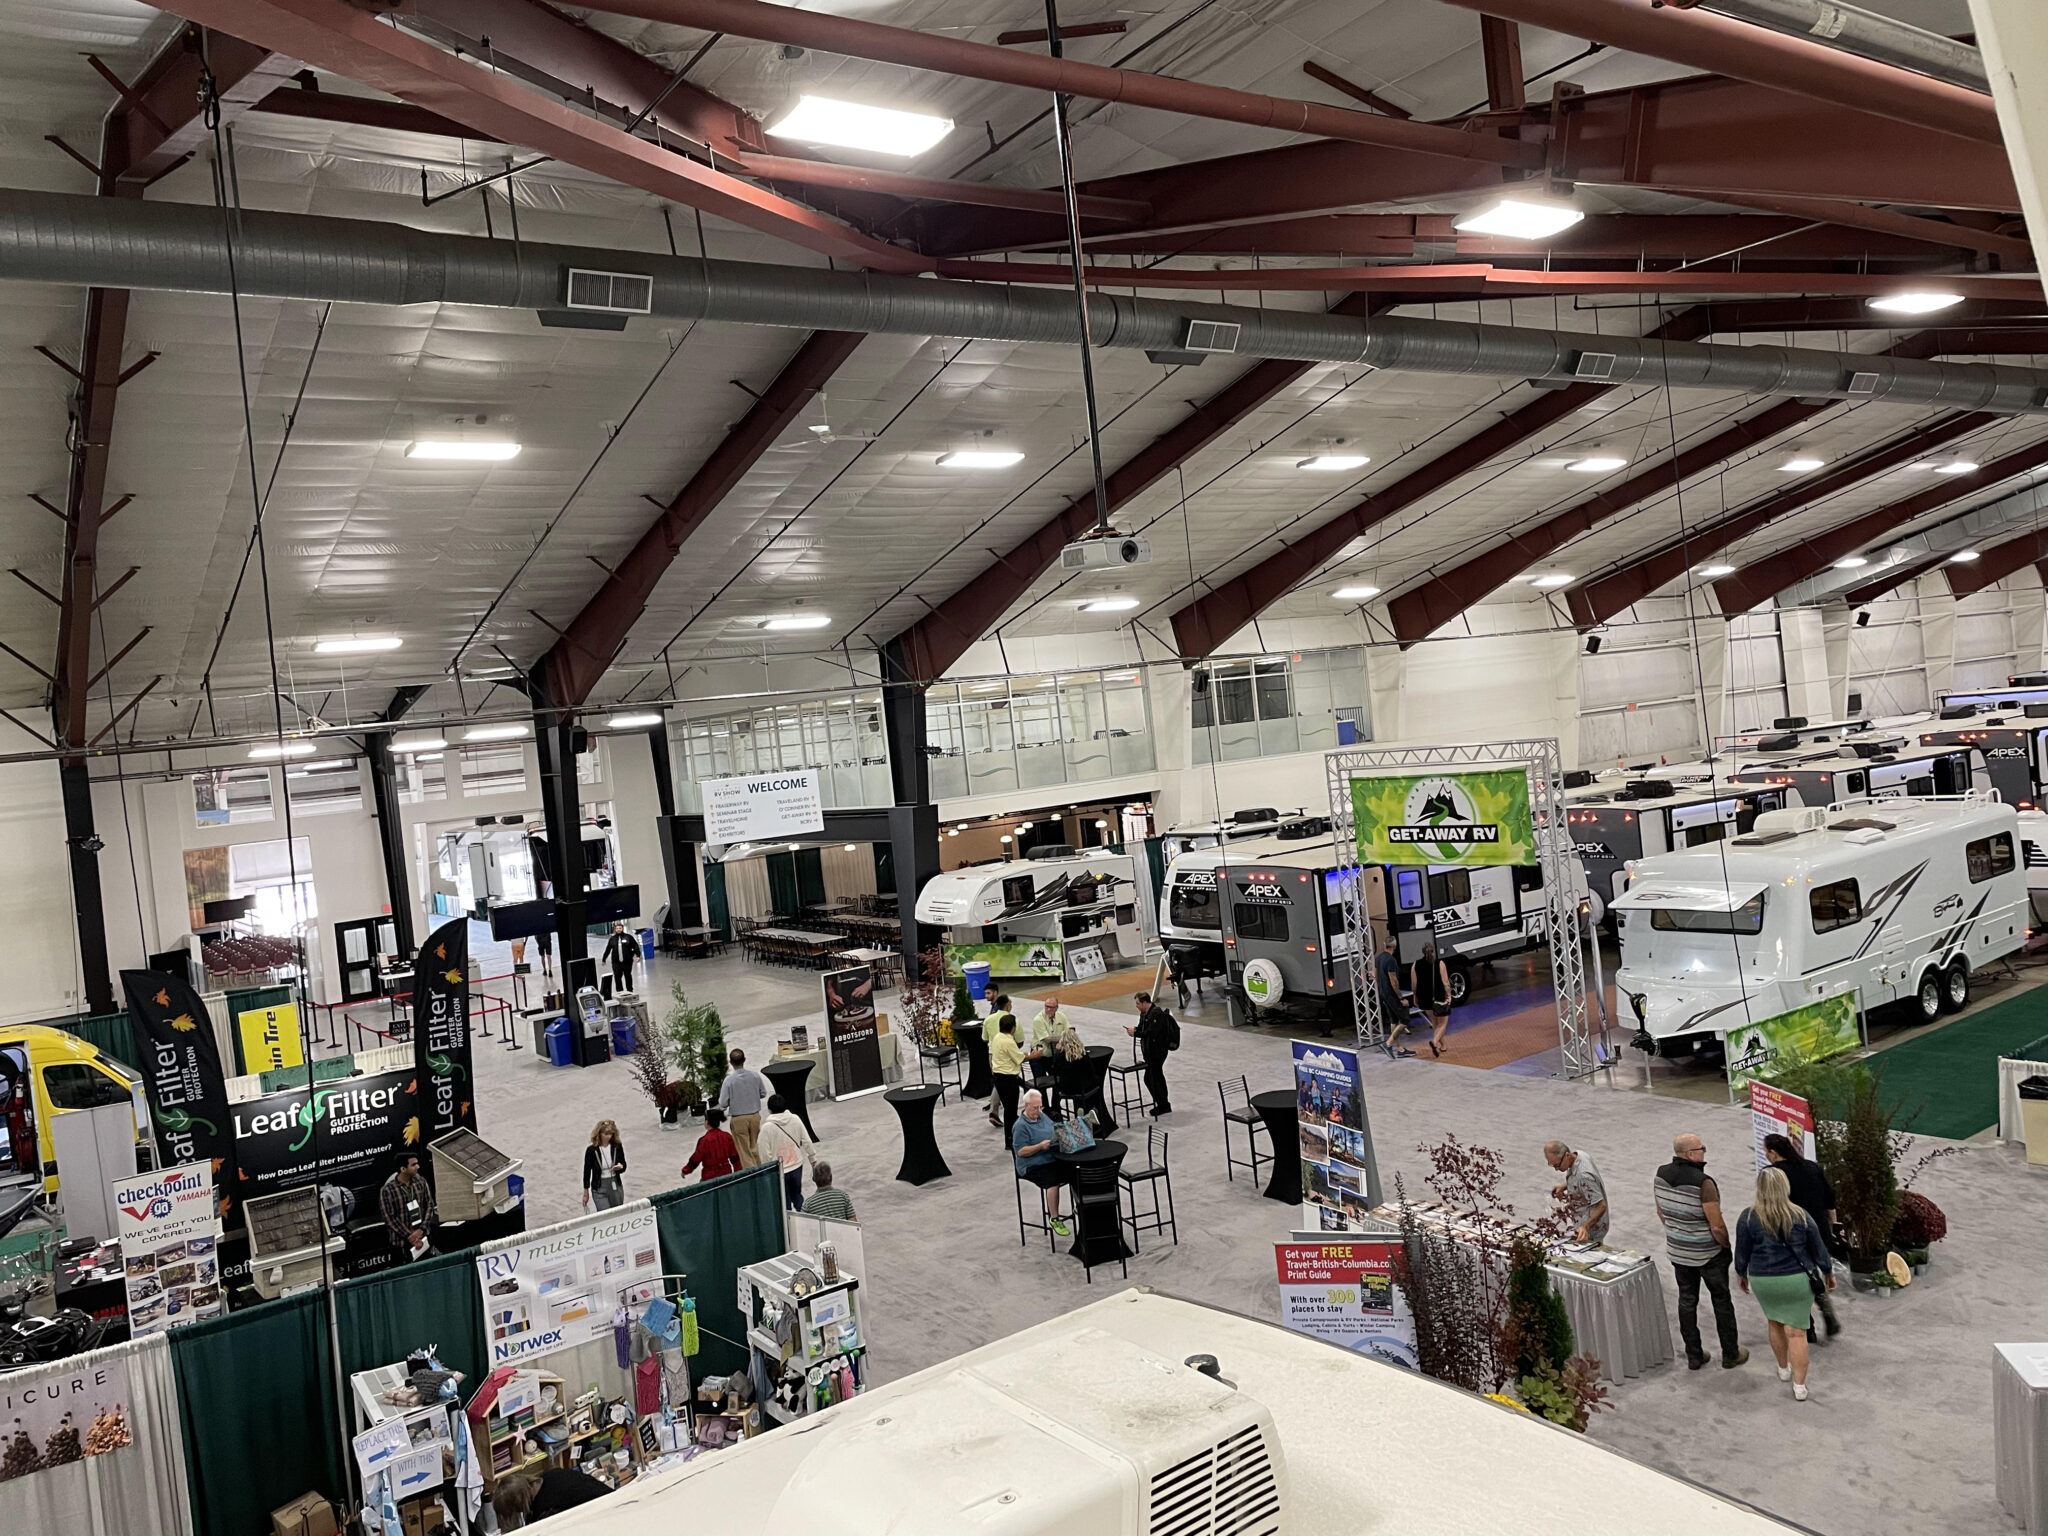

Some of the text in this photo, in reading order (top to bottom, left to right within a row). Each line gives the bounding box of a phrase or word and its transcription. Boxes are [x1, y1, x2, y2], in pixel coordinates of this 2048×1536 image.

[1986, 747, 2026, 757] APEX
[747, 777, 808, 794] WELCOME
[716, 809, 737, 817] SEMINAR
[1389, 827, 1497, 841] GET-AWAY RV
[1576, 843, 1604, 853] PEX
[1183, 873, 1216, 884] APEX
[1244, 884, 1281, 897] APEX
[263, 1011, 279, 1045] Tire
[448, 1016, 458, 1049] GUTTER
[453, 997, 464, 1048] PROTECTION
[834, 1028, 874, 1042] ABBOTSFORD
[429, 990, 454, 1130] Leaf Filter
[155, 1041, 186, 1107] Filter
[186, 1046, 204, 1100] PROTECTION
[182, 1067, 194, 1102] GUTTER
[234, 1085, 399, 1139] Leaf Filter
[330, 1113, 367, 1128] GUTTER
[330, 1116, 389, 1136] PROTECTION
[257, 1171, 276, 1181] How
[277, 1166, 297, 1177] Does
[298, 1157, 336, 1172] Leafilter
[337, 1151, 365, 1163] Handle
[365, 1143, 392, 1156] Water?
[117, 1172, 203, 1206] checkpoint
[176, 1188, 213, 1203] YAMAHA
[124, 1214, 212, 1239] WE'VE GOT YOU
[483, 1249, 521, 1280] RV
[528, 1232, 584, 1260] must
[591, 1213, 654, 1241] haves
[1285, 1246, 1353, 1260] Get your FREE
[219, 1259, 253, 1280] eaf
[1287, 1270, 1332, 1279] Print Guide
[1290, 1296, 1308, 1304] With
[1327, 1289, 1356, 1304] 300
[1291, 1305, 1315, 1313] places
[1327, 1305, 1343, 1314] stay
[494, 1328, 562, 1360] Norwex
[7, 1370, 107, 1409] ICURE
[355, 1425, 404, 1452] REPLACE THIS
[397, 1452, 435, 1473] WITH THIS
